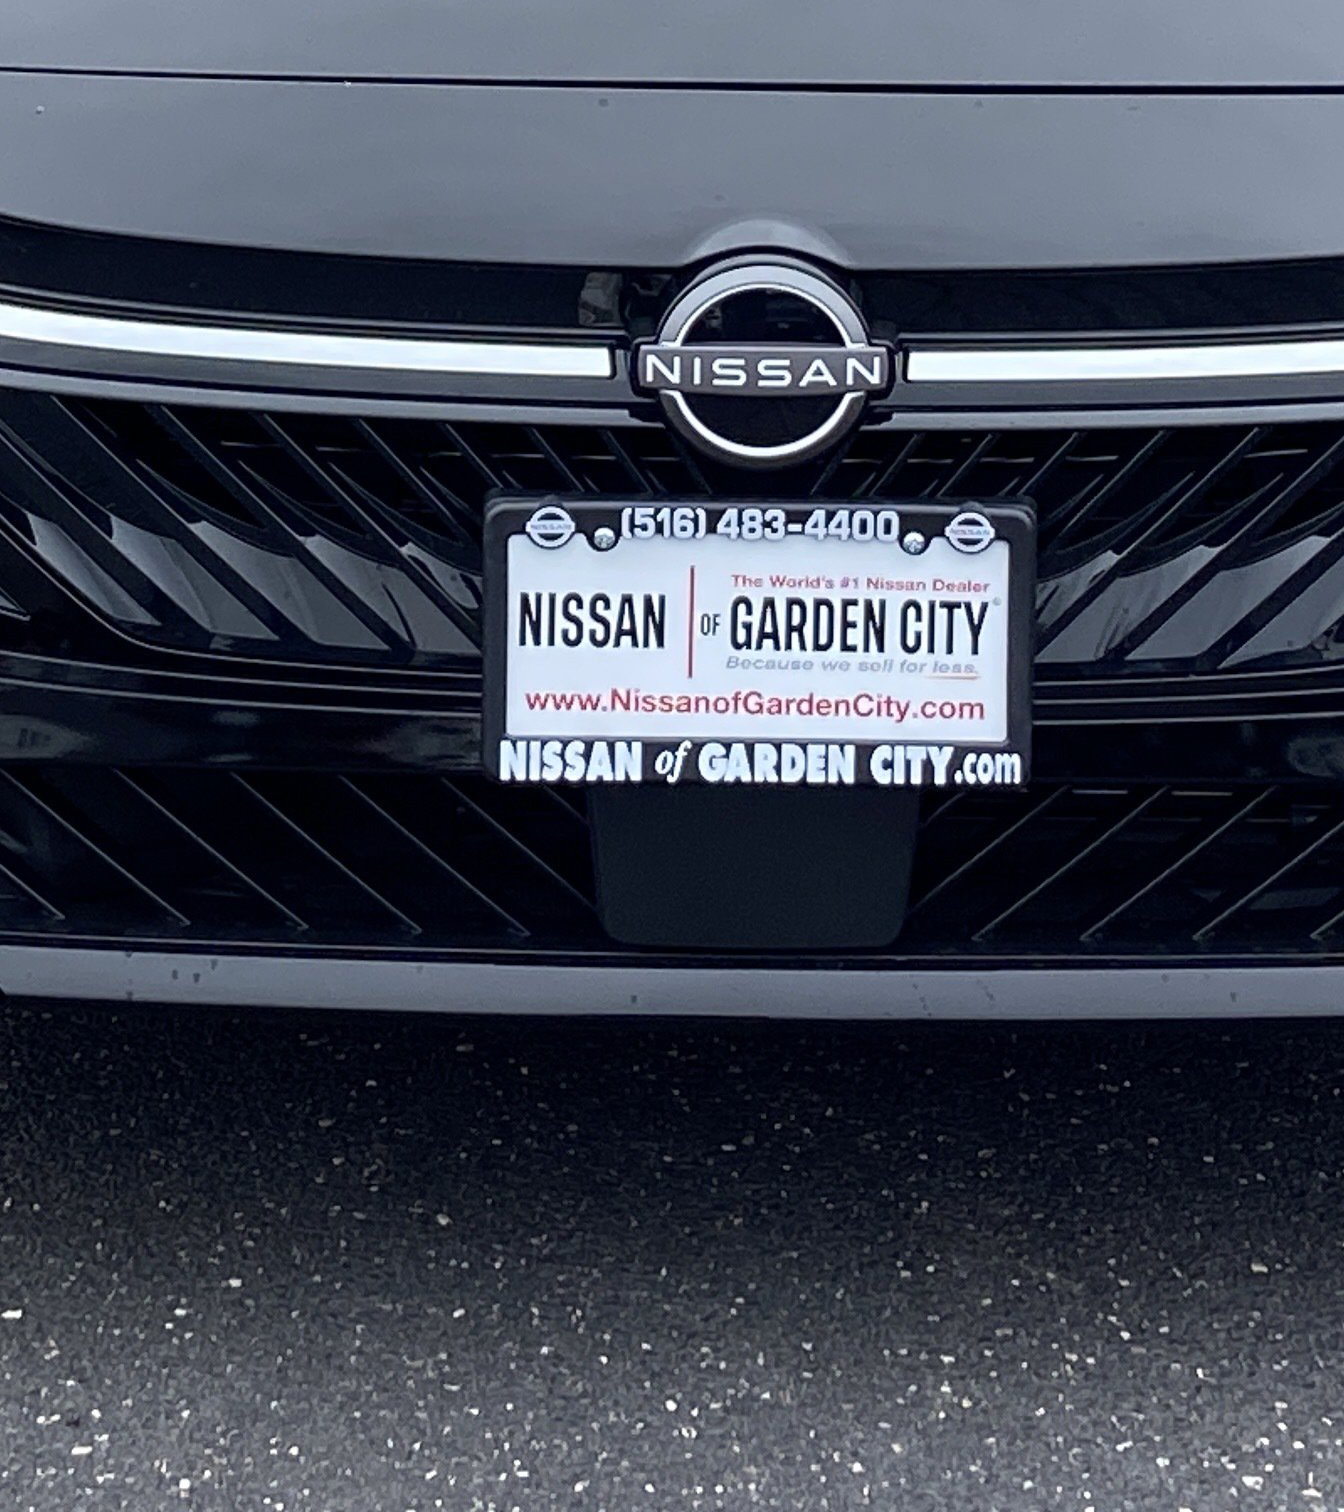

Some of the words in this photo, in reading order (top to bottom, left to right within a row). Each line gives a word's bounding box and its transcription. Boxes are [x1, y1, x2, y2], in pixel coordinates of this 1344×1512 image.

[645, 354, 881, 387] NISSAN
[621, 507, 706, 539] (516)
[716, 508, 900, 542] 483-4400
[731, 574, 763, 588] The
[769, 575, 834, 589] World's
[839, 576, 860, 589] #1
[866, 577, 927, 591] Nissan
[932, 579, 991, 593] Dealer
[518, 591, 666, 649] NISSAN
[700, 613, 721, 636] OF
[730, 595, 886, 654] GARDEN
[900, 598, 990, 656] CITY
[726, 655, 814, 670] Because
[821, 660, 851, 672] we
[857, 659, 895, 673] sell
[899, 659, 928, 674] for
[932, 661, 979, 674] less.
[525, 688, 986, 723] www.NissanofGardenCity.com
[499, 740, 643, 782] NISSAN
[654, 740, 692, 783] of
[698, 742, 856, 784] GARDEN
[869, 744, 1022, 786] CITY.com
